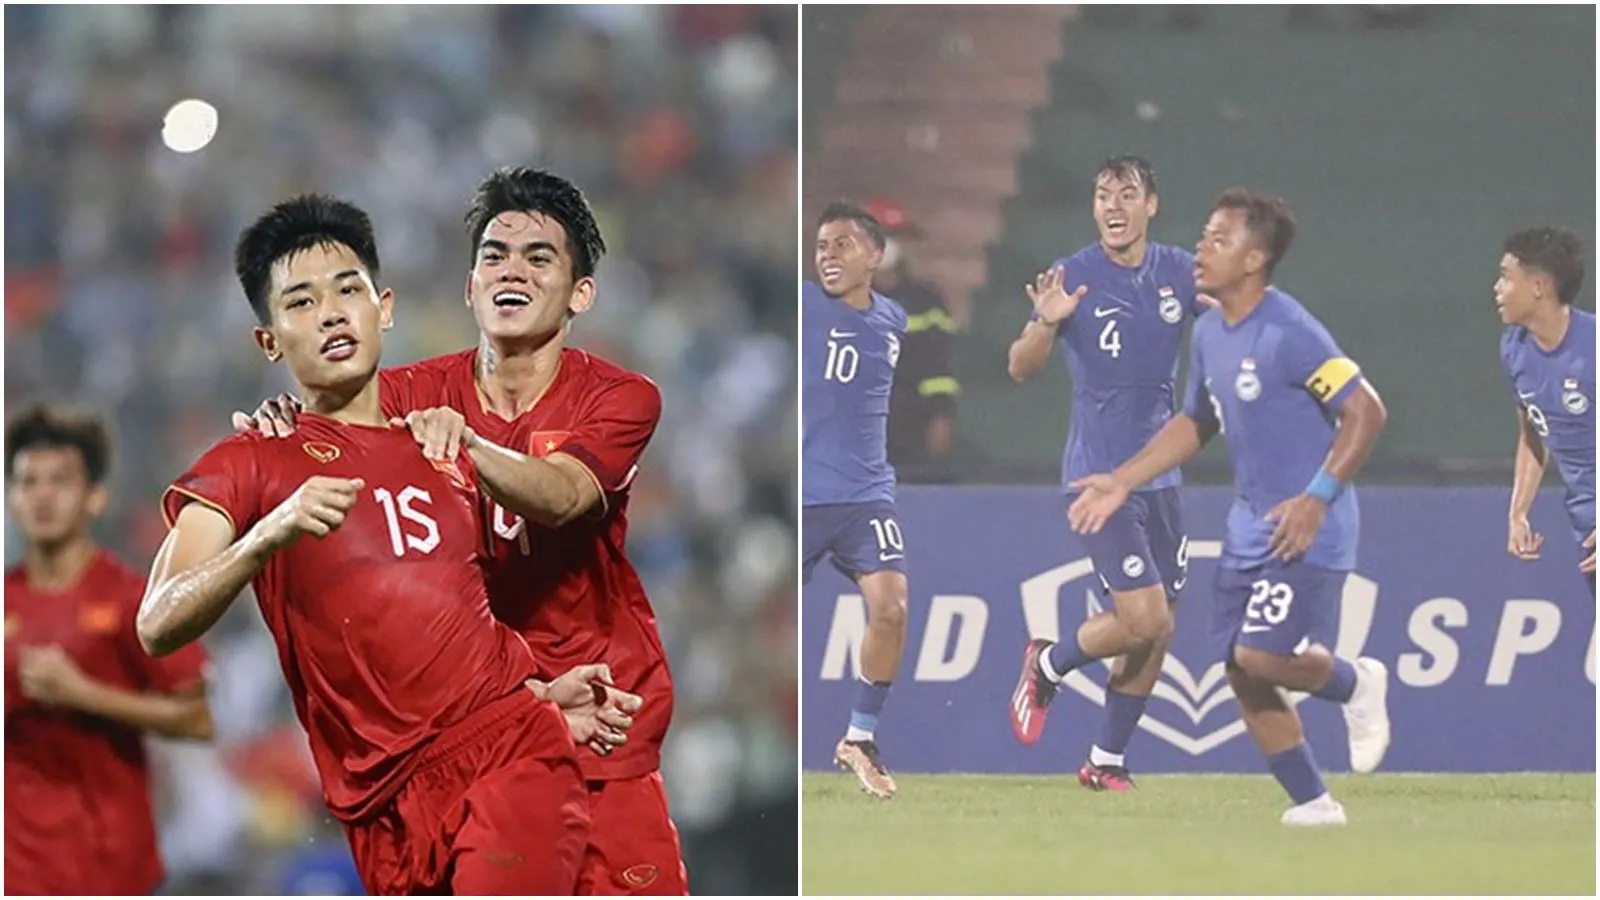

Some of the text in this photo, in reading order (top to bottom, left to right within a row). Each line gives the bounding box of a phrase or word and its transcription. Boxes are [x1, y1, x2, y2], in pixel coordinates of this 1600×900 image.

[1099, 319, 1122, 358] 4
[824, 340, 859, 383] 10
[1310, 377, 1331, 398] C
[373, 485, 441, 557] 15
[869, 518, 904, 550] 10
[1245, 579, 1294, 624] 23
[1397, 597, 1596, 687] SP
